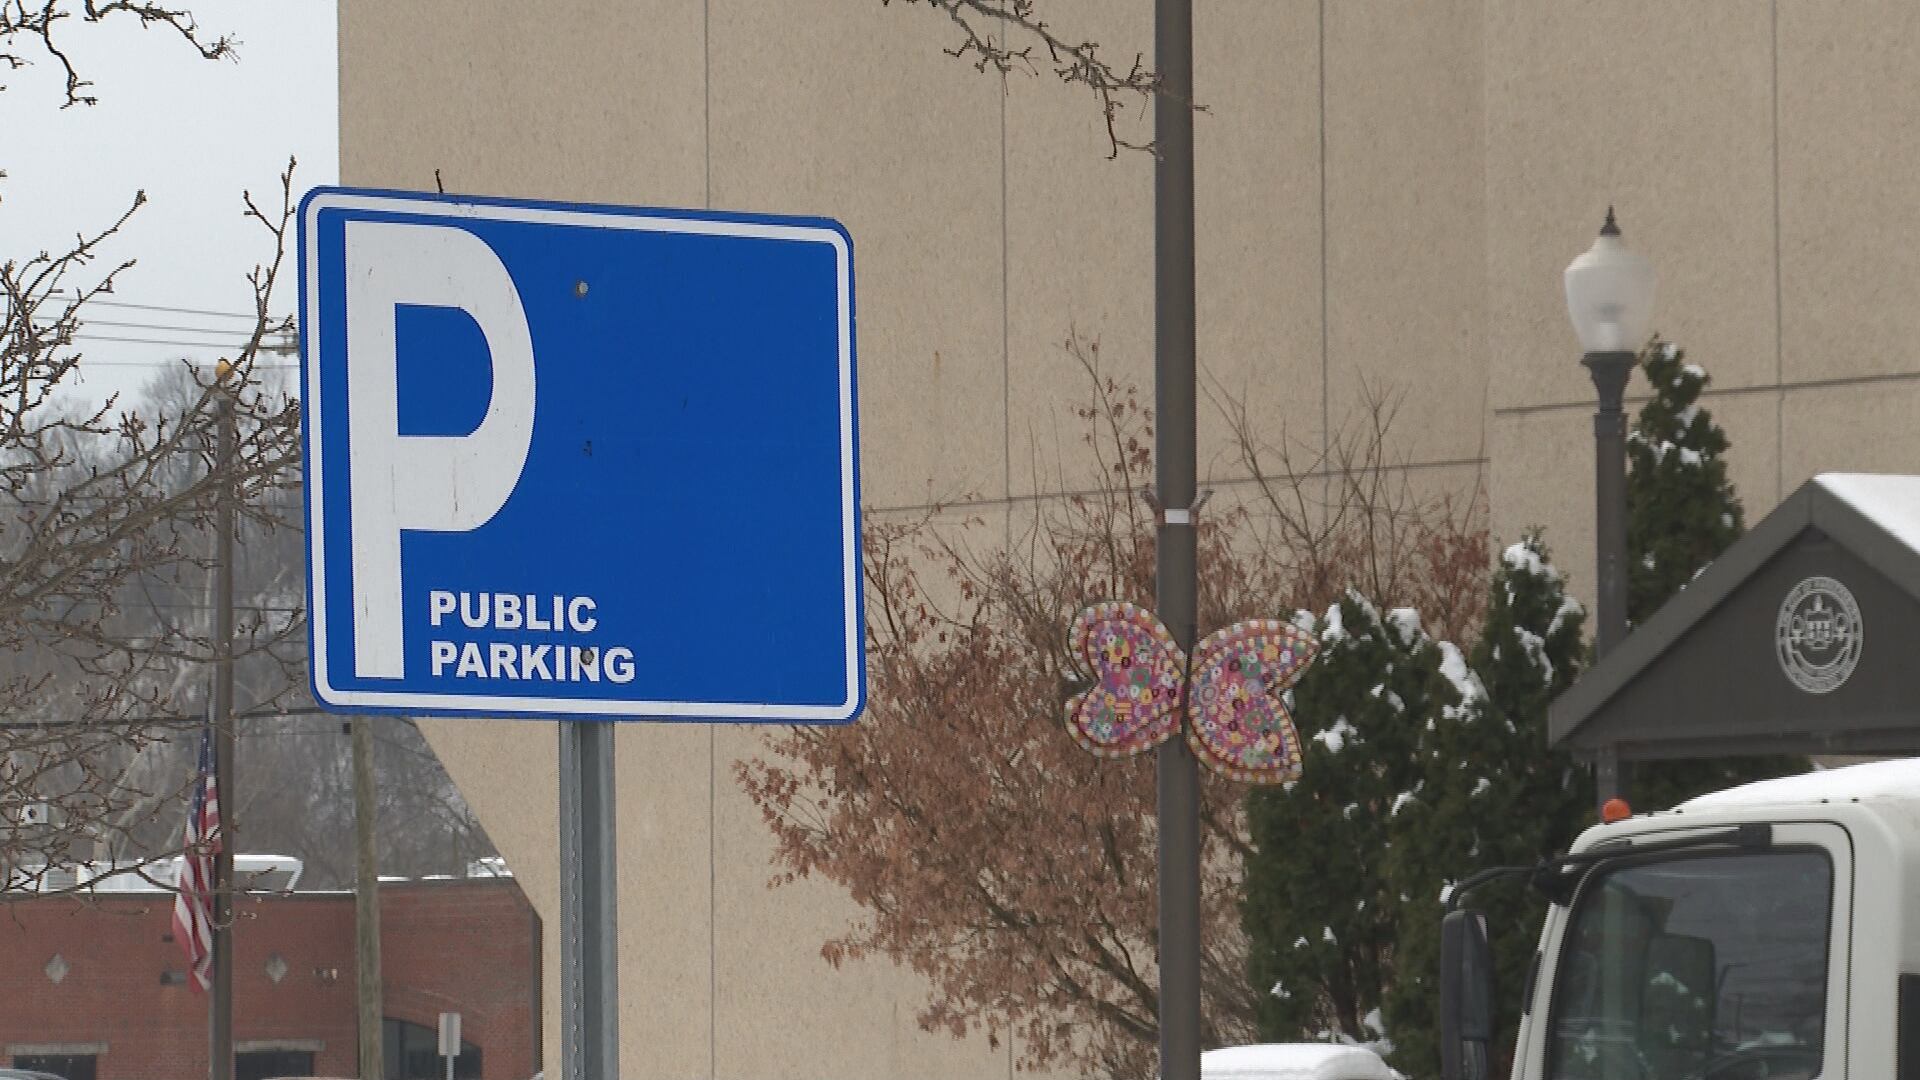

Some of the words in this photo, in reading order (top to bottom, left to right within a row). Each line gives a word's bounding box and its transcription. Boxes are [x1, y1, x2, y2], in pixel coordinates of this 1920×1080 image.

[344, 220, 537, 680] P
[429, 590, 598, 632] PUBLIC
[431, 640, 636, 684] PARKING
